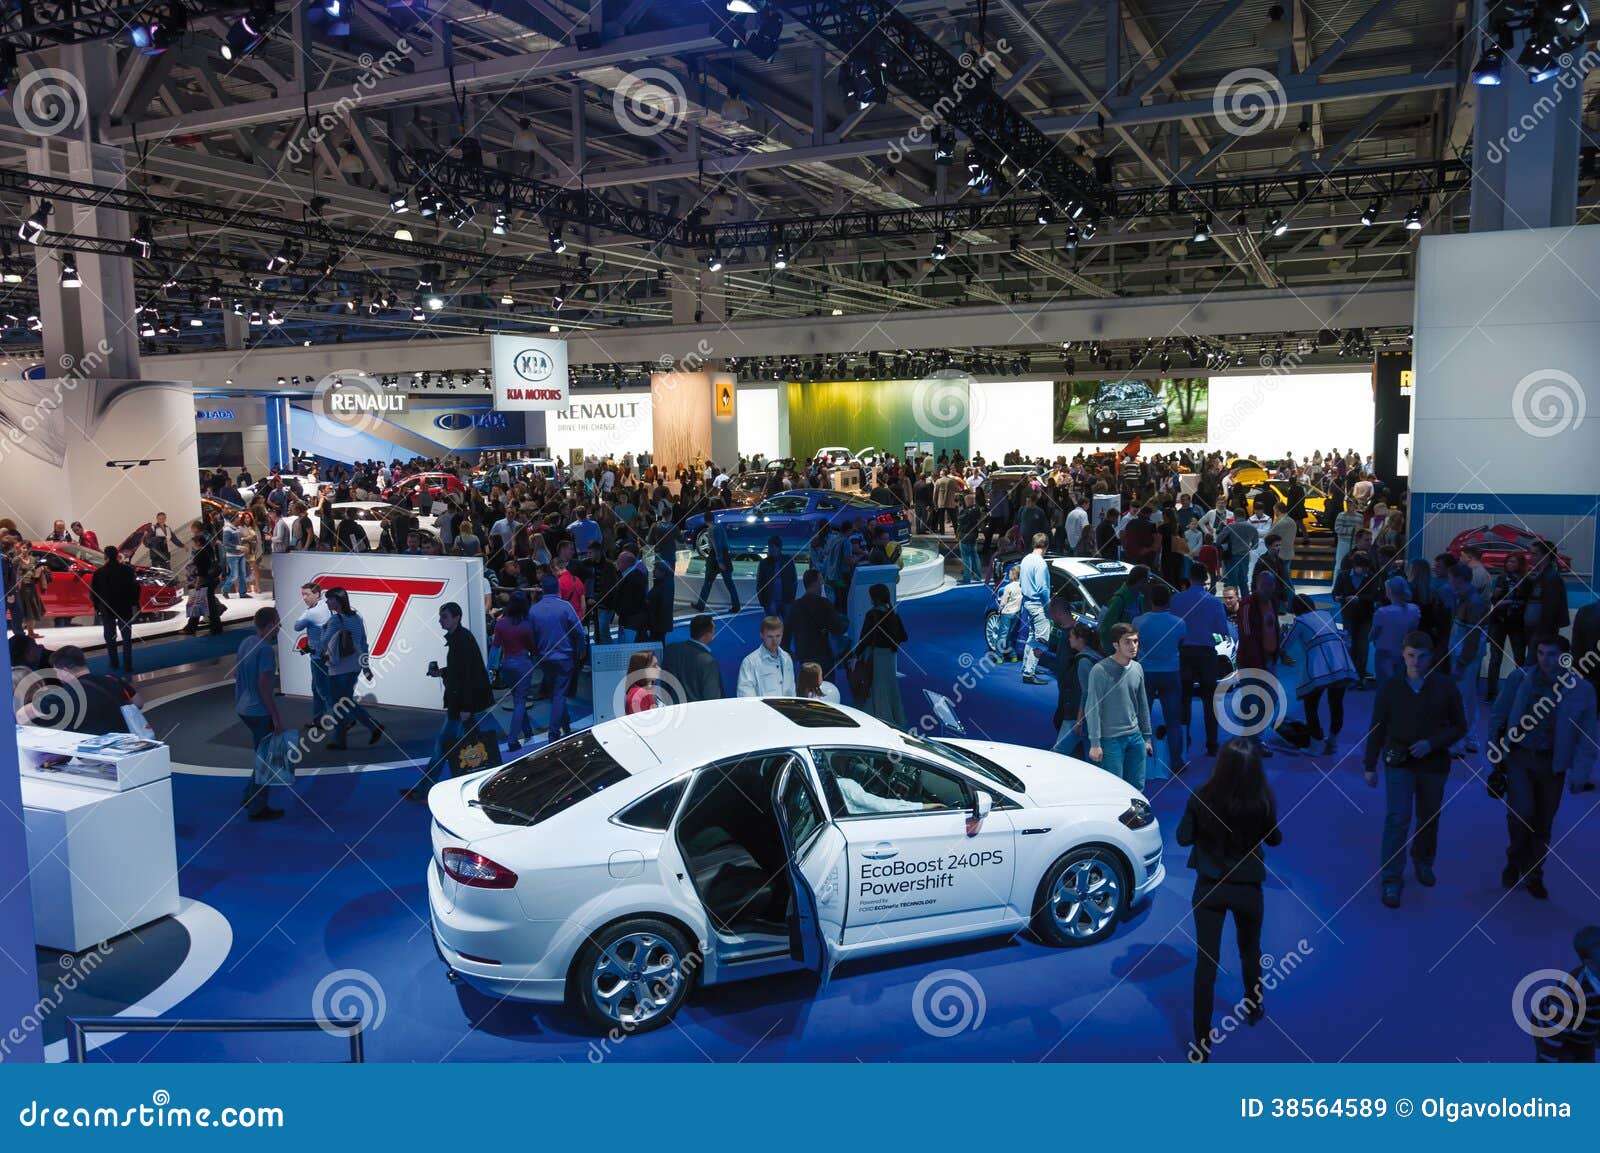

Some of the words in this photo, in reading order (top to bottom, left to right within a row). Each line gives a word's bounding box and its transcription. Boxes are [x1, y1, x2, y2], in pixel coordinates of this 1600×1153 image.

[331, 393, 406, 411] RENAULT
[507, 389, 523, 400] KIA
[525, 389, 562, 400] MOTORS
[557, 402, 639, 420] RENAULT
[578, 423, 589, 431] THE
[591, 423, 616, 431] CHANGE
[1431, 502, 1456, 510] FORD
[1457, 503, 1485, 511] EVOS
[861, 857, 944, 879] EcoBoost
[948, 850, 1004, 870] 240PS
[860, 873, 954, 896] Powershift
